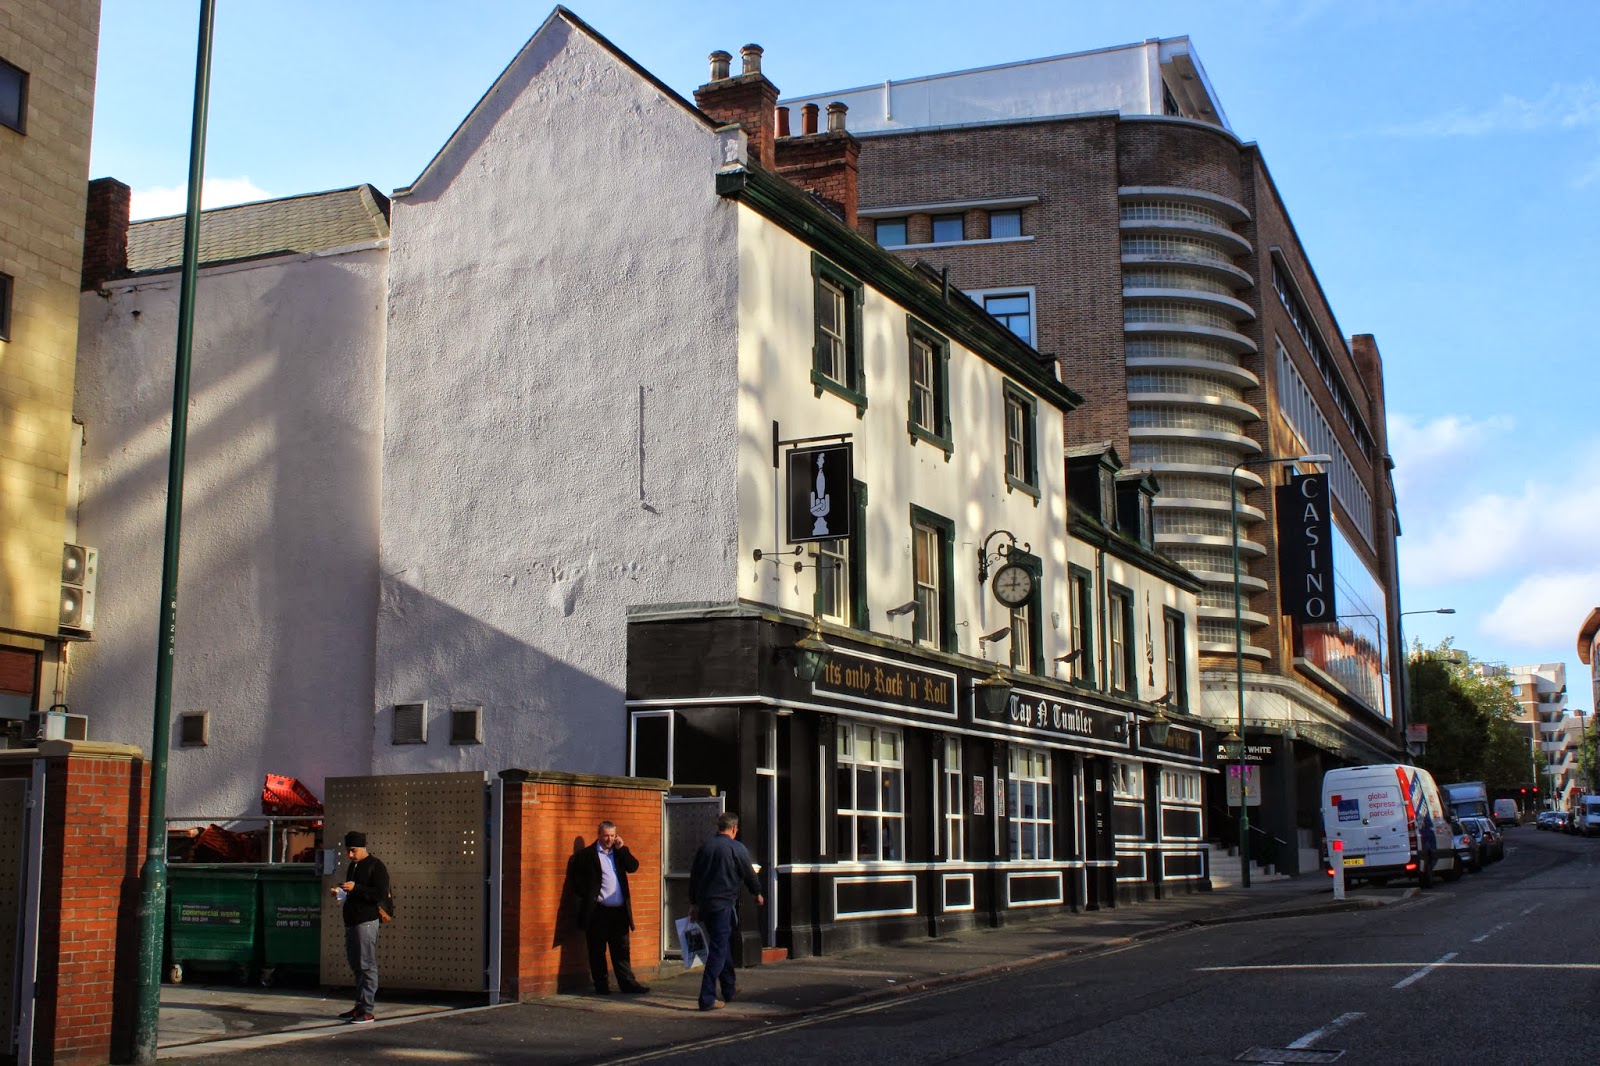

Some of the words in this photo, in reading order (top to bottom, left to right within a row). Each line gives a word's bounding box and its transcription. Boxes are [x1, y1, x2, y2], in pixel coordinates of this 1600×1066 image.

[1301, 477, 1326, 618] CASINO
[845, 664, 870, 695] only
[874, 666, 903, 697] Rock
[924, 678, 947, 705] Roll
[1009, 694, 1032, 727] Tap
[1036, 700, 1048, 728] N
[1052, 703, 1093, 735] Tumbler
[1248, 746, 1272, 754] WHITE
[1368, 792, 1388, 801] global
[1369, 801, 1396, 809] express
[1369, 809, 1395, 818] parcels
